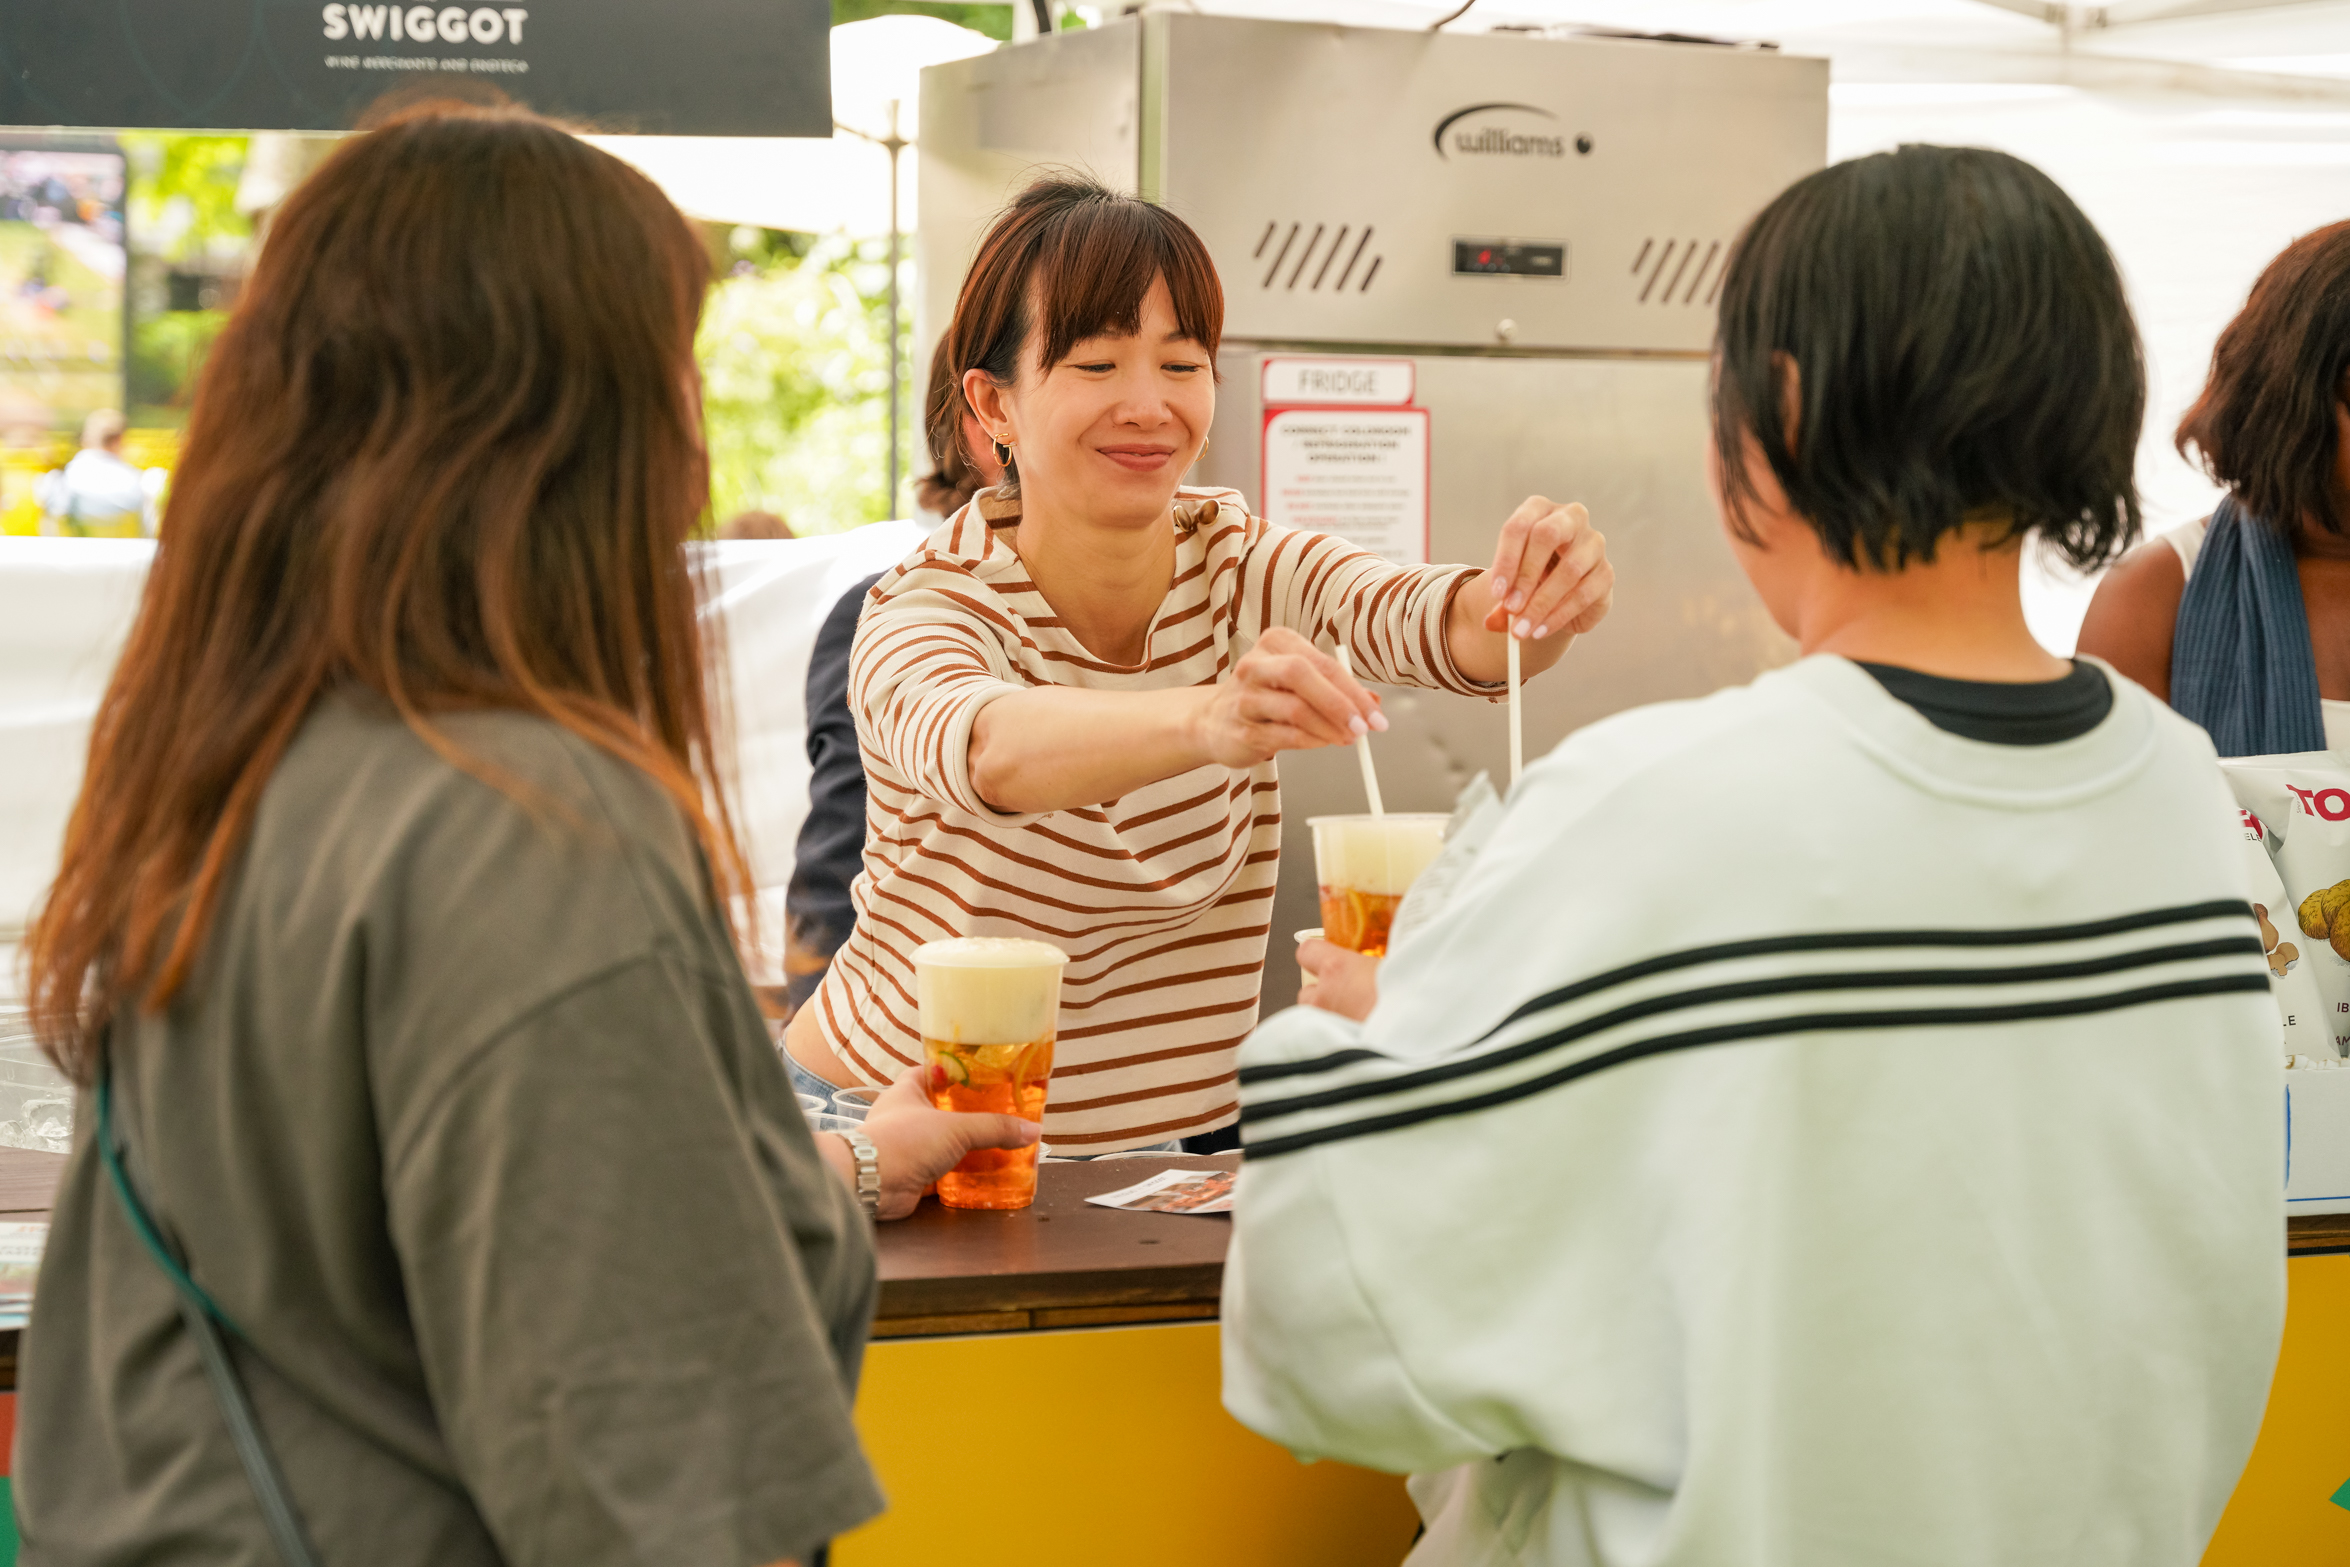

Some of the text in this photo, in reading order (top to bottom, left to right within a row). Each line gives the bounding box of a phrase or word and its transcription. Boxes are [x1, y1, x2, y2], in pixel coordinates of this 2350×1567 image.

[322, 3, 528, 45] SWIGGOT
[324, 55, 360, 69] WINE
[1456, 128, 1564, 157] williams
[1299, 370, 1379, 395] FRIDGE
[2285, 784, 2350, 822] TO
[2336, 1002, 2349, 1013] IB
